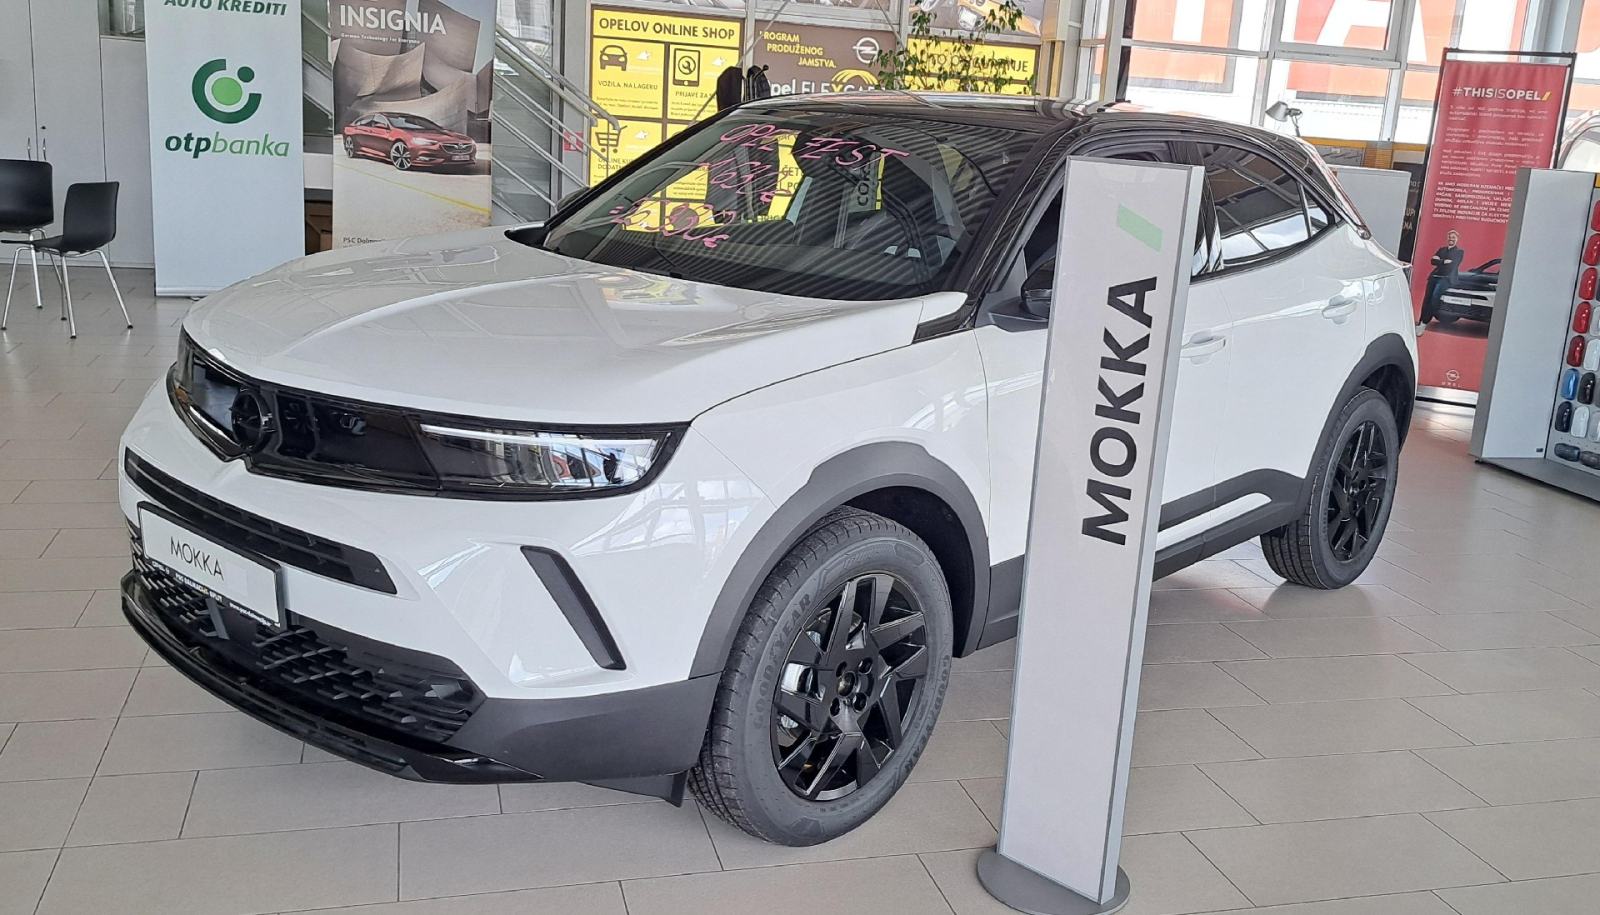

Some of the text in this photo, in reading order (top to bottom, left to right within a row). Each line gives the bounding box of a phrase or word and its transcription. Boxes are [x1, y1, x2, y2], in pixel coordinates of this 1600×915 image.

[217, 0, 287, 15] KREDITI
[339, 4, 447, 35] INSIGNIA
[599, 17, 735, 40] OPELOV ONLINE SHOP
[766, 43, 824, 56] PRODUŽENOG
[798, 57, 836, 68] JAMSTVA.
[1452, 87, 1542, 100] #THISISOPEL
[165, 131, 290, 159] otpbanka
[1082, 276, 1157, 546] MOKKA
[170, 536, 225, 582] MOKKA
